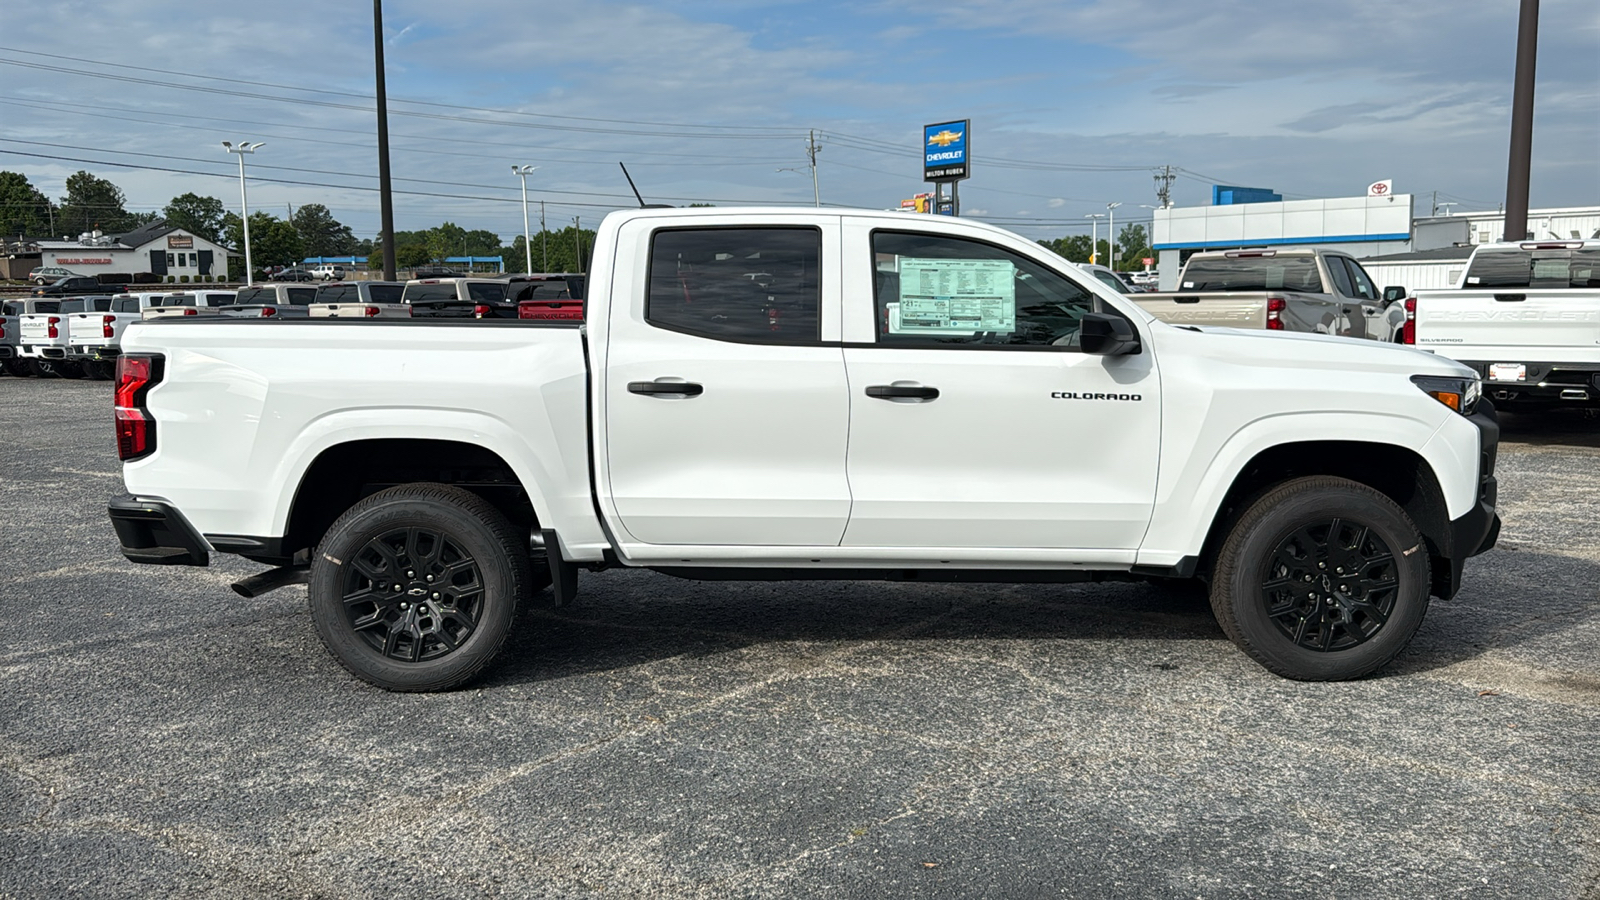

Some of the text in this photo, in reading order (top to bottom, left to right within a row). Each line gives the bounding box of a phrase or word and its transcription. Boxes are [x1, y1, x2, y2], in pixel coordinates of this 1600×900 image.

[926, 151, 962, 161] CHEVROLET
[1427, 310, 1596, 321] CHEVROLET
[1051, 391, 1142, 401] COLORADO
